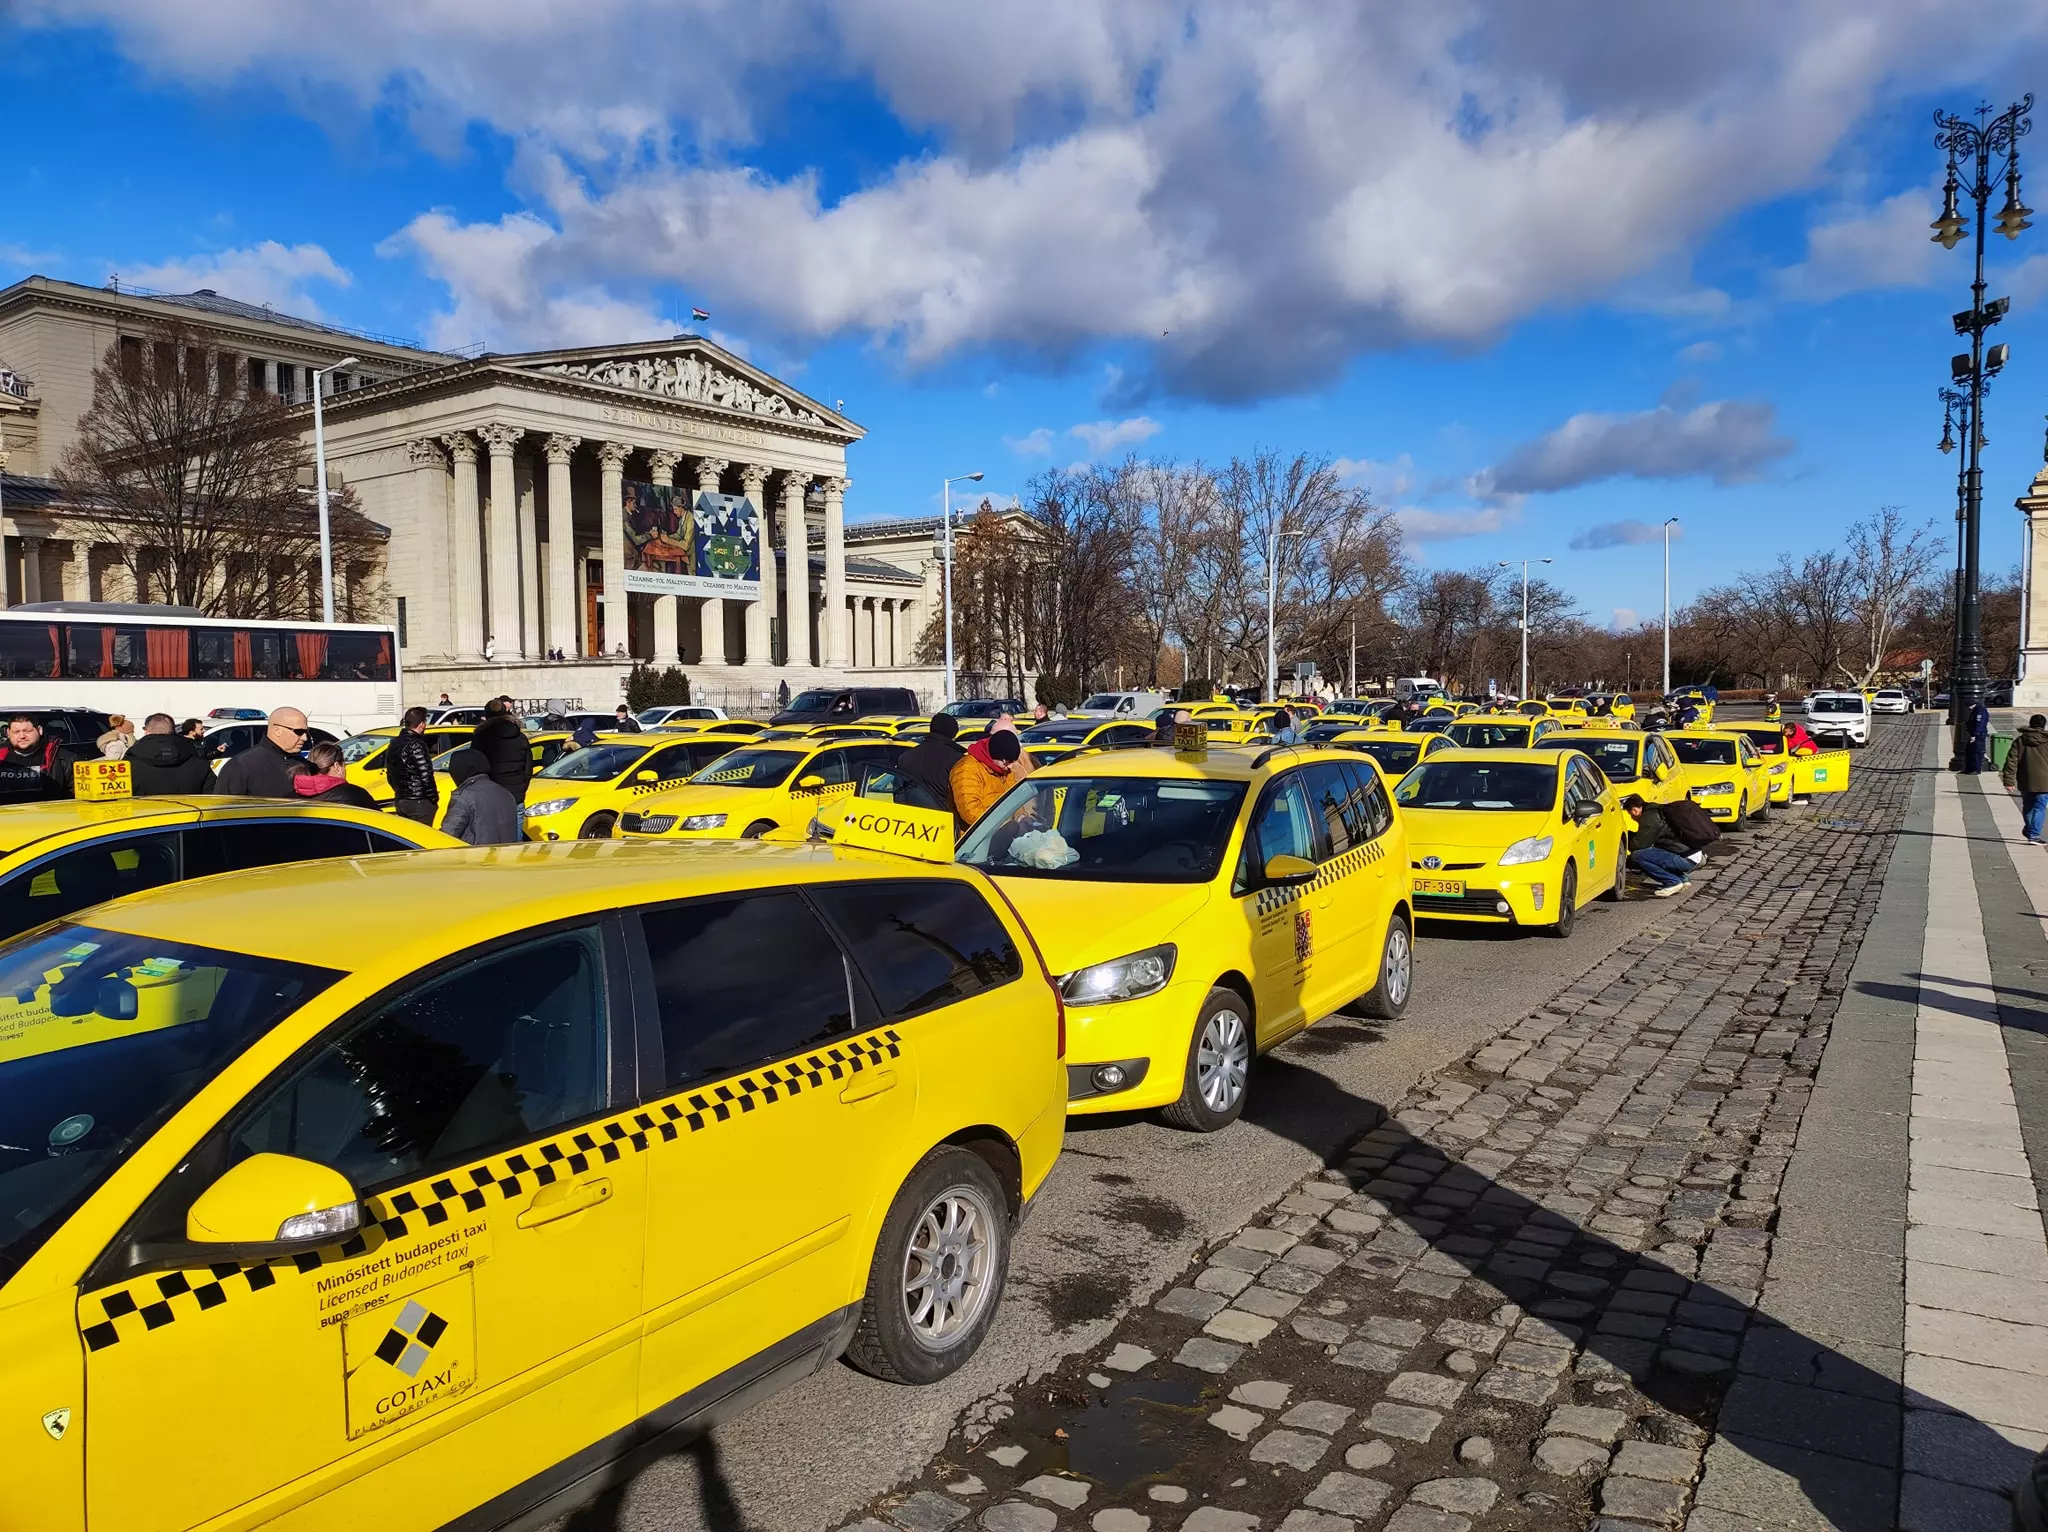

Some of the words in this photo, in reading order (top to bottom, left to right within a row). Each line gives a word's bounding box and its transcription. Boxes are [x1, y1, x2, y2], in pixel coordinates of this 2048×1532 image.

[77, 782, 91, 792] TAXI
[101, 781, 126, 791] TAXI
[1414, 880, 1460, 894] DF-399
[317, 1256, 391, 1294] Minősített
[395, 1230, 460, 1265] budapesti
[463, 1219, 488, 1238] taxi
[319, 1277, 379, 1311] Licensed
[383, 1252, 442, 1287] Budapest
[446, 1242, 469, 1262] taxi
[354, 1416, 387, 1436] PLAN
[398, 1393, 439, 1415] ORDER
